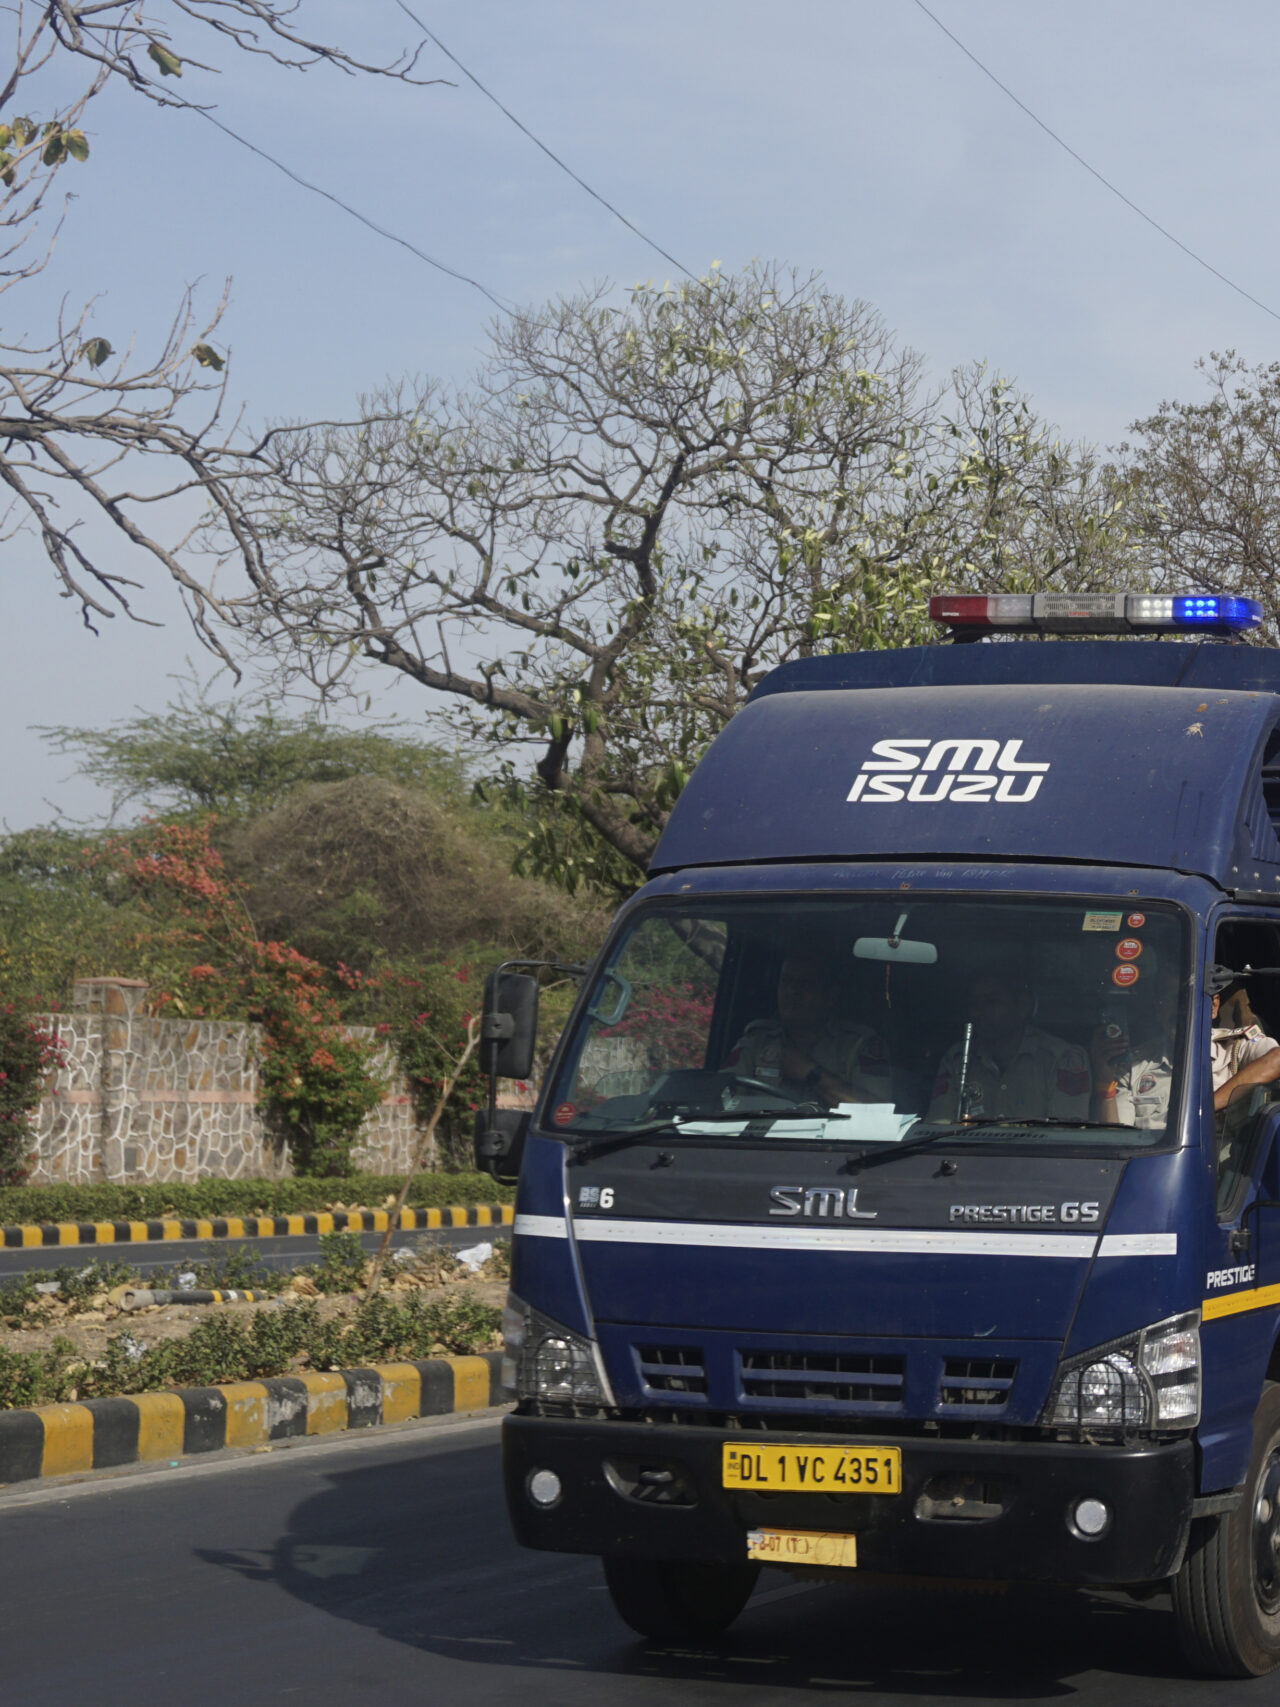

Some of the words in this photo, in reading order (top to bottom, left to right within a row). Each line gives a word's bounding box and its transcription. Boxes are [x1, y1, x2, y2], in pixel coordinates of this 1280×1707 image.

[861, 739, 1050, 771] SML
[846, 774, 1044, 802] ISUZU
[769, 1186, 877, 1219] SML
[950, 1205, 1056, 1222] PRESTIGE
[1060, 1201, 1099, 1222] GS
[1206, 1264, 1255, 1289] PRESTIGE
[741, 1454, 768, 1481] DL
[833, 1457, 892, 1485] 4351
